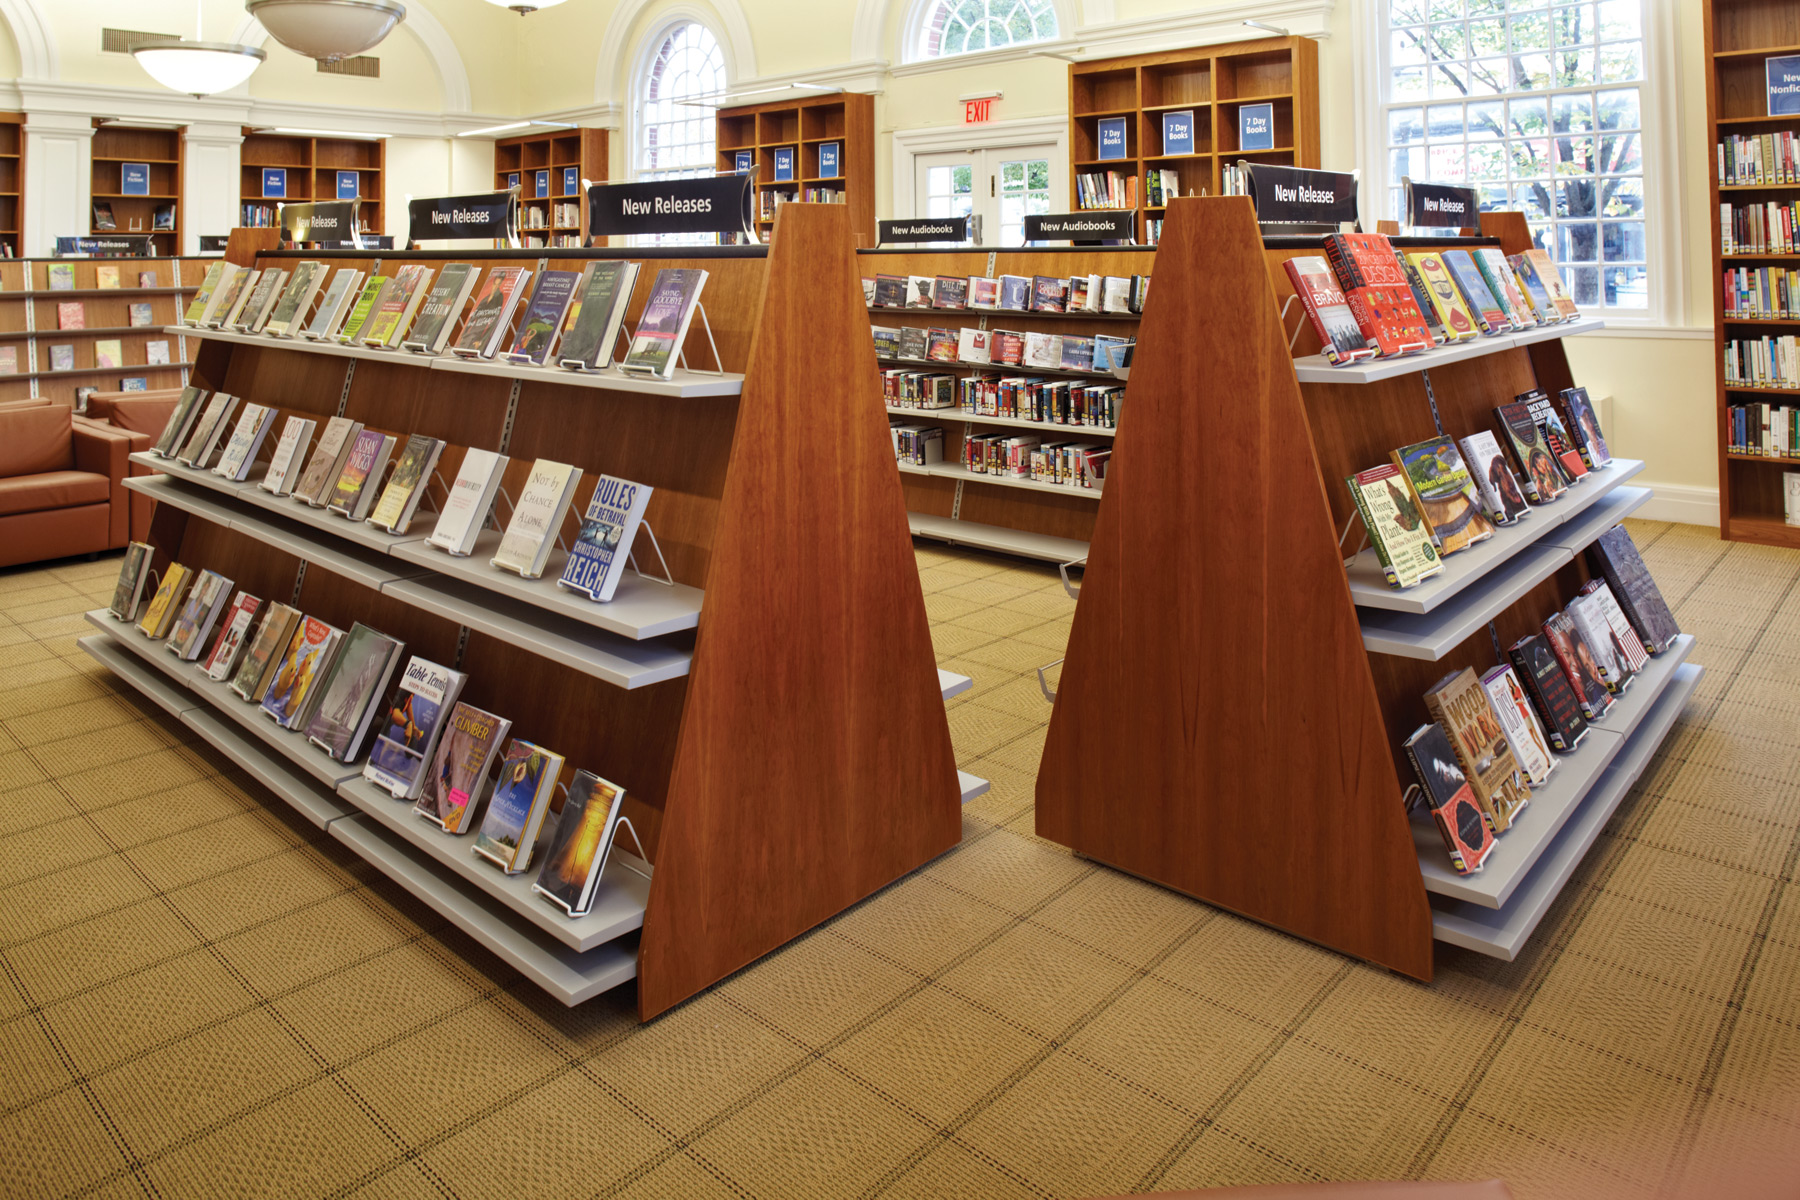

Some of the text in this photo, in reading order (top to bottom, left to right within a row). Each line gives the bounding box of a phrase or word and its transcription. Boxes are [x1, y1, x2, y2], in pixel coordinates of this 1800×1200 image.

[1770, 83, 1800, 94] Nonfic
[966, 100, 991, 123] EXIT
[1175, 124, 1188, 132] Day
[1253, 117, 1266, 126] Day
[1109, 129, 1121, 138] Day
[1169, 132, 1188, 140] Books
[1246, 126, 1267, 134] Books
[1103, 136, 1121, 145] Books
[822, 158, 836, 166] Books
[828, 152, 836, 160] Day
[1275, 184, 1335, 204] New Releases
[622, 195, 712, 216] New Releases
[1424, 197, 1465, 213] New Releases
[296, 215, 338, 228] New Releases
[432, 207, 490, 225] New Releases
[892, 224, 953, 235] New Audiobooks
[1040, 220, 1116, 232] New Audiobooks
[1361, 265, 1405, 283] DESIGN
[432, 287, 451, 296] PRESENT
[1313, 291, 1345, 306] BRAVO
[653, 296, 684, 305] GOODBYE
[1302, 296, 1315, 319] BRAVO
[421, 302, 451, 316] CREATION
[1347, 295, 1365, 326] DESIGN
[355, 436, 378, 455] SUSAN
[350, 450, 373, 471] WIGGS
[551, 476, 560, 492] by
[1416, 479, 1437, 490] Modern
[1435, 473, 1453, 485] Garden
[593, 478, 637, 511] RULES
[1363, 484, 1386, 500] What's
[1369, 500, 1395, 514] Wrong
[588, 504, 627, 527] OF BETRAYAL
[574, 541, 614, 564] CHRISTOPHER
[563, 554, 608, 592] REICH
[406, 663, 447, 692] Table Tennis
[408, 681, 420, 690] STEPS
[1446, 683, 1486, 729] WOOD
[455, 715, 489, 741] CLIMBER
[1459, 706, 1501, 758] WORK
[509, 792, 517, 800] THE
